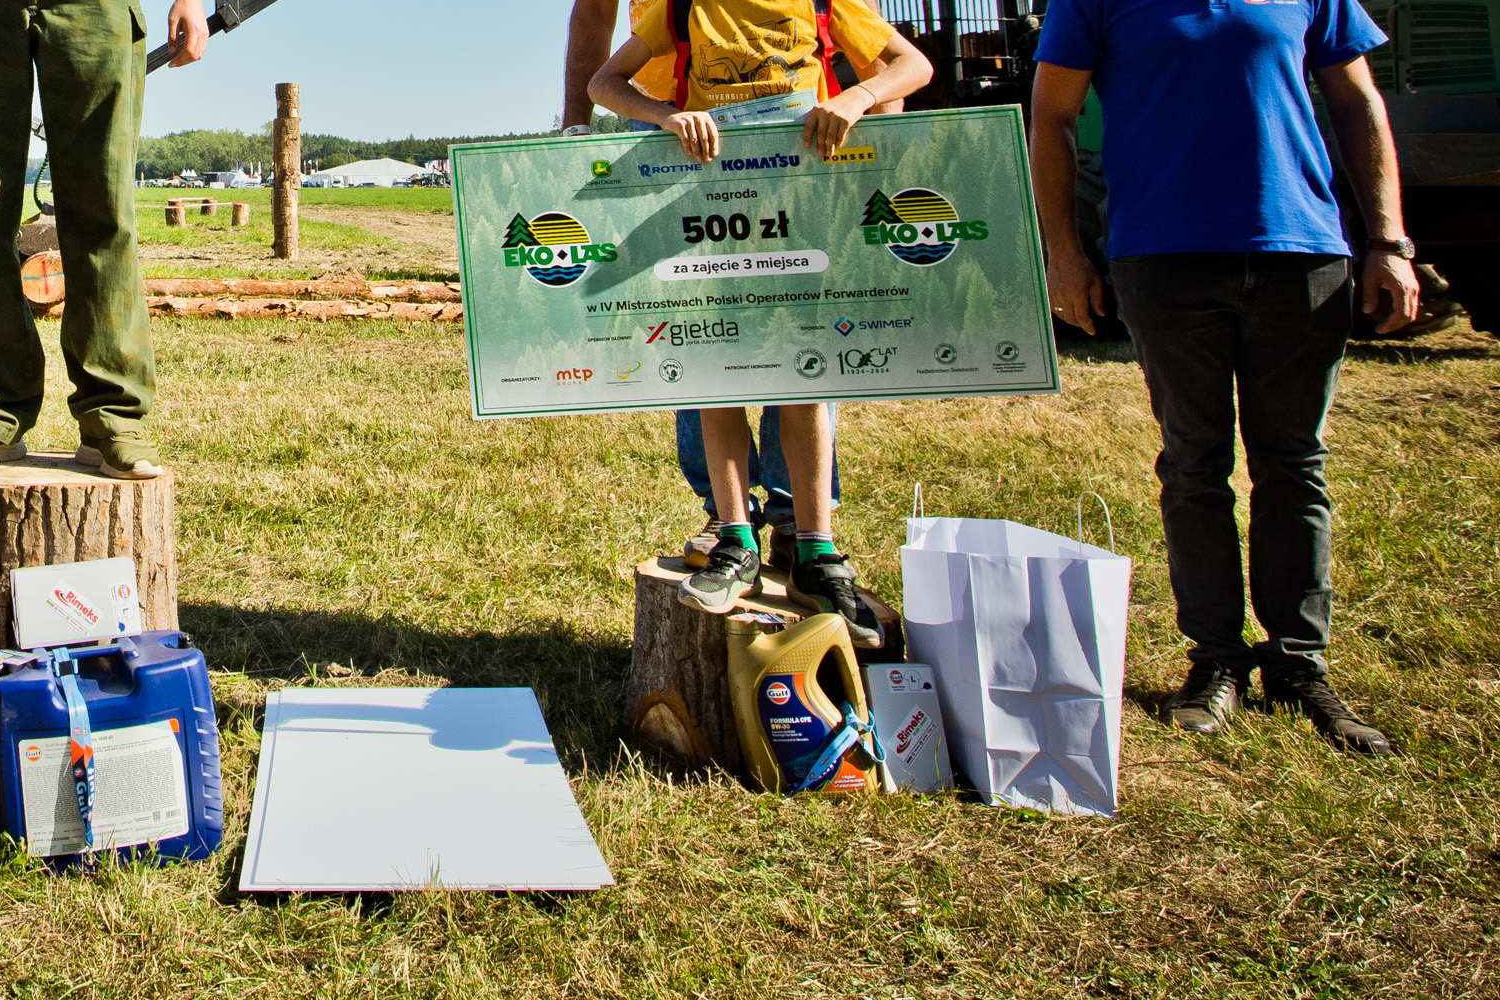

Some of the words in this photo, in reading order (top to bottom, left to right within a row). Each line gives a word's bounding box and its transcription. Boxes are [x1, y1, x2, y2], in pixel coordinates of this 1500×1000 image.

[652, 164, 703, 174] ROTTNE
[721, 153, 800, 172] KOMATSU
[823, 152, 874, 162] PONSSE
[706, 189, 758, 202] nagroda
[682, 212, 750, 244] 500
[760, 210, 789, 239] zł
[862, 222, 919, 245] EKO
[936, 220, 990, 242] LAS
[504, 244, 554, 267] EKO
[570, 242, 618, 264] LAS
[674, 264, 688, 274] za
[692, 260, 740, 274] zajęcie
[743, 258, 752, 270] 3
[756, 257, 809, 270] miejsca
[586, 304, 597, 312] w
[600, 302, 612, 312] IV
[616, 297, 702, 310] Mistrzostwach
[706, 294, 742, 306] Polski
[746, 290, 820, 305] Operatorów
[824, 286, 910, 299] Forwarderów
[670, 319, 740, 346] giełda
[879, 347, 898, 355] LAT
[556, 368, 593, 382] mtp
[66, 591, 98, 623] Rimeks
[896, 710, 924, 742] Rimeks
[76, 782, 88, 821] Gulf
